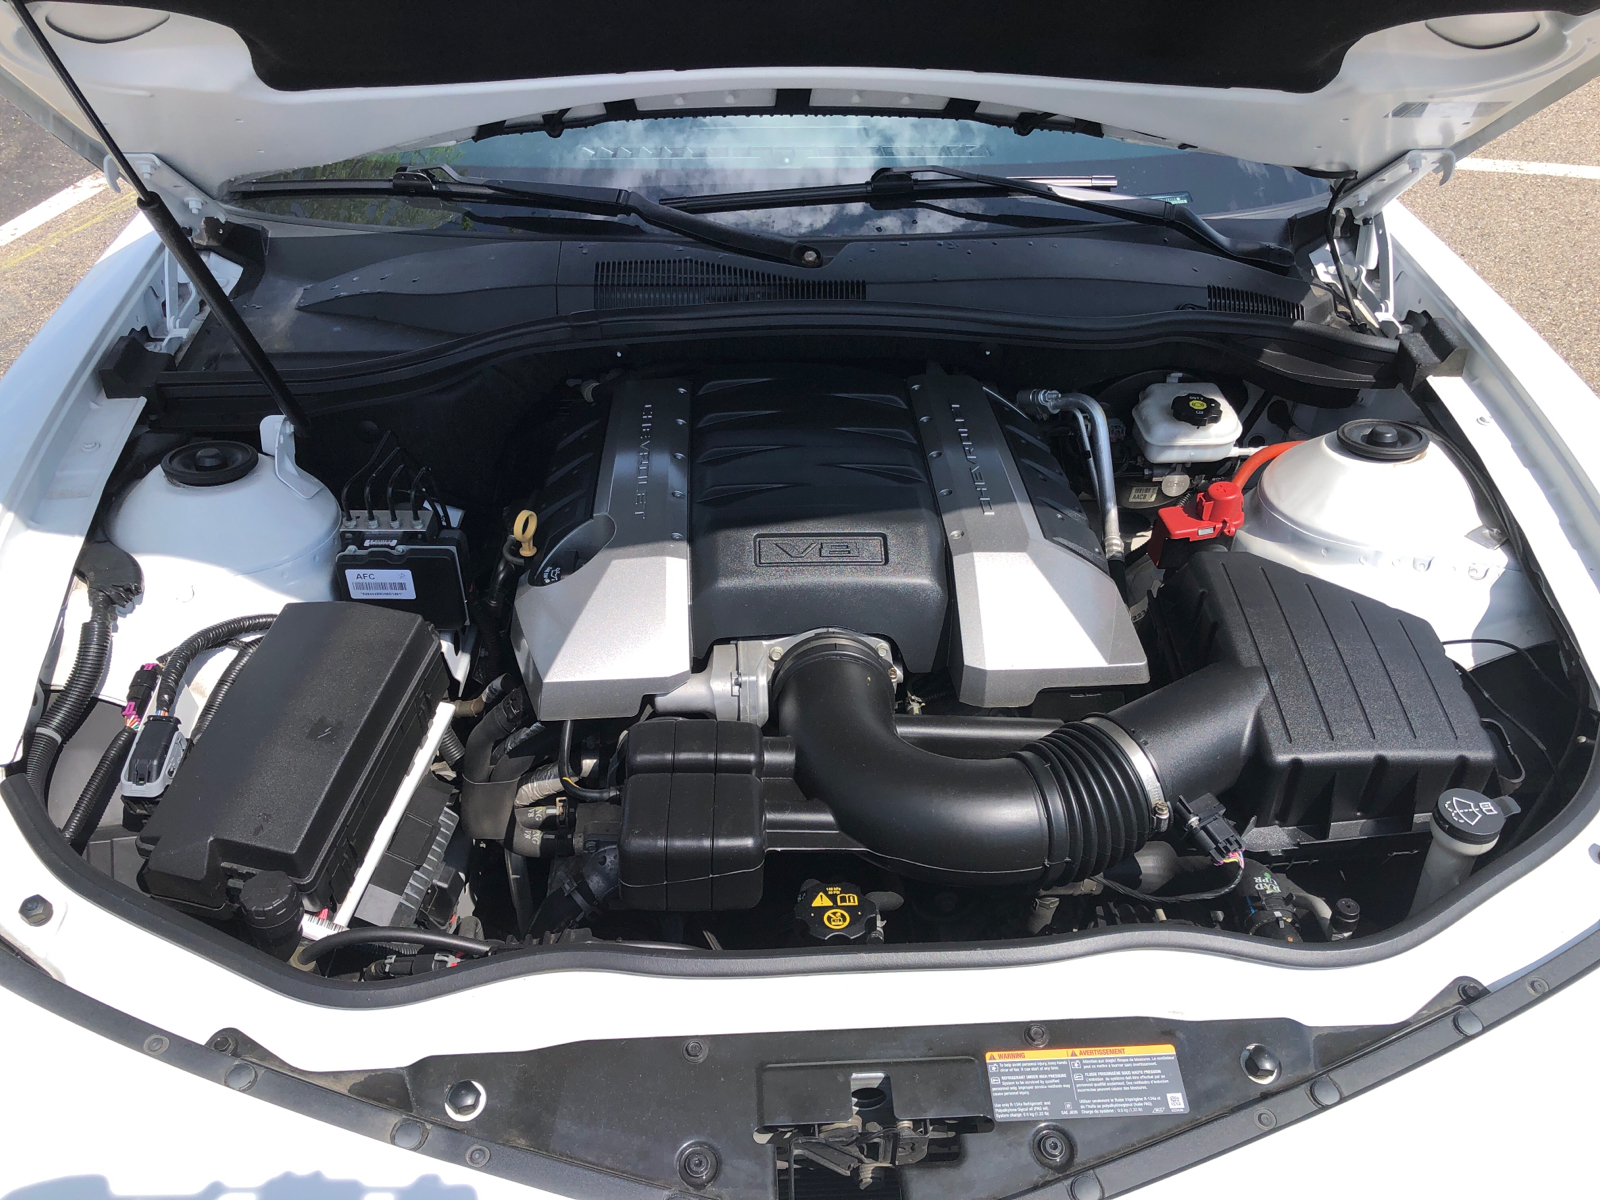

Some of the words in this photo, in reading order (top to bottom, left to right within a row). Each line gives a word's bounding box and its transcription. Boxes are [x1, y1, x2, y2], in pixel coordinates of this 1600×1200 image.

[634, 404, 653, 520] CHEVROLET
[948, 401, 995, 516] CHEVROLET
[774, 541, 860, 558] V8
[1078, 1048, 1126, 1056] AVERTISSEMENT
